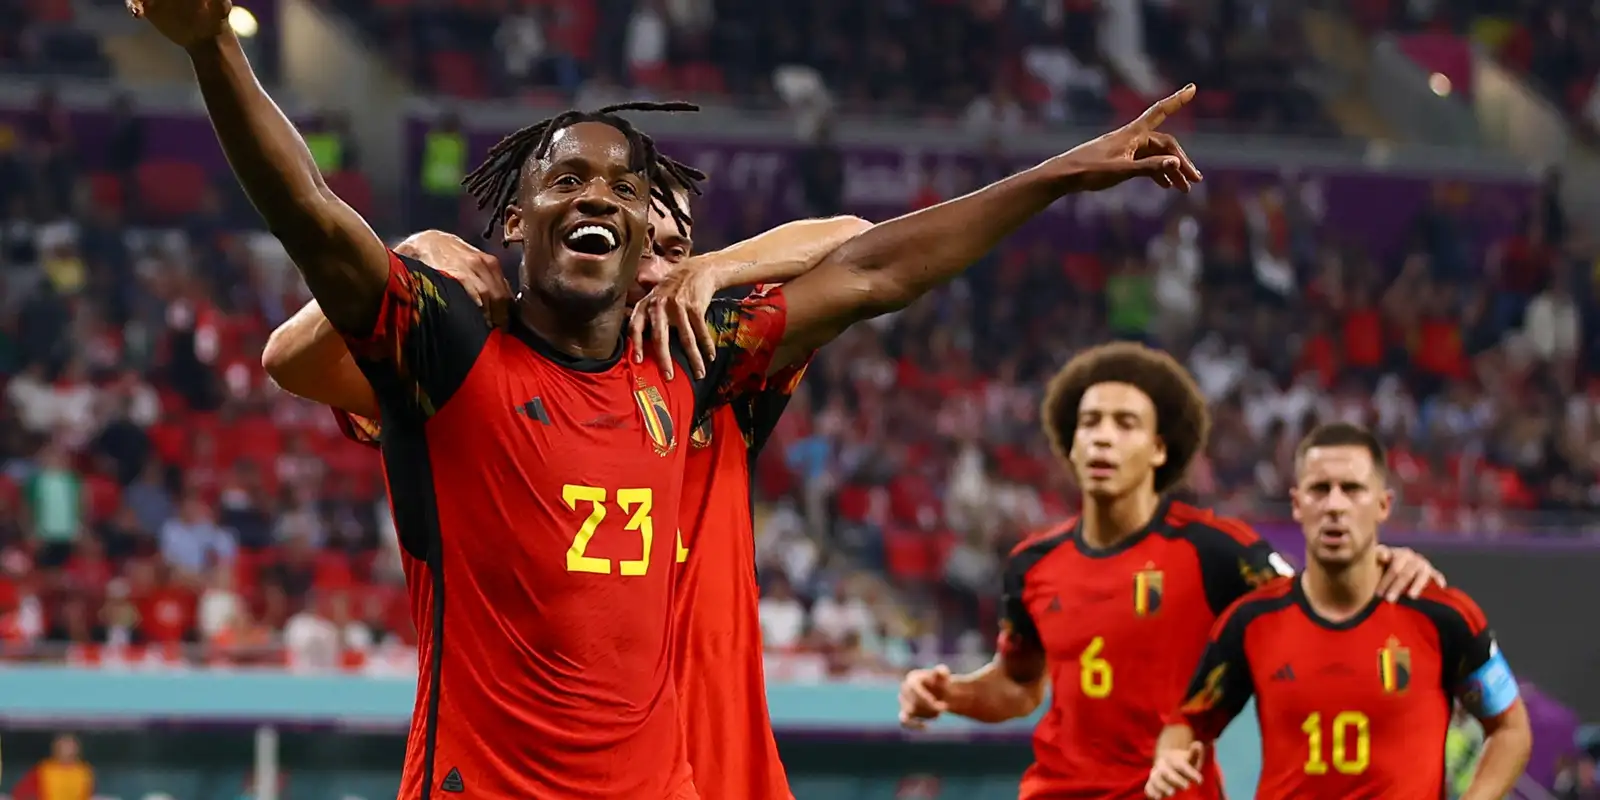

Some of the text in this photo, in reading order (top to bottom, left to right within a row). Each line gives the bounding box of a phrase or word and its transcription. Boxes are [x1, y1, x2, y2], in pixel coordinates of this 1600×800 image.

[562, 484, 653, 576] 23
[1080, 637, 1112, 698] 6
[1302, 711, 1371, 775] 10
